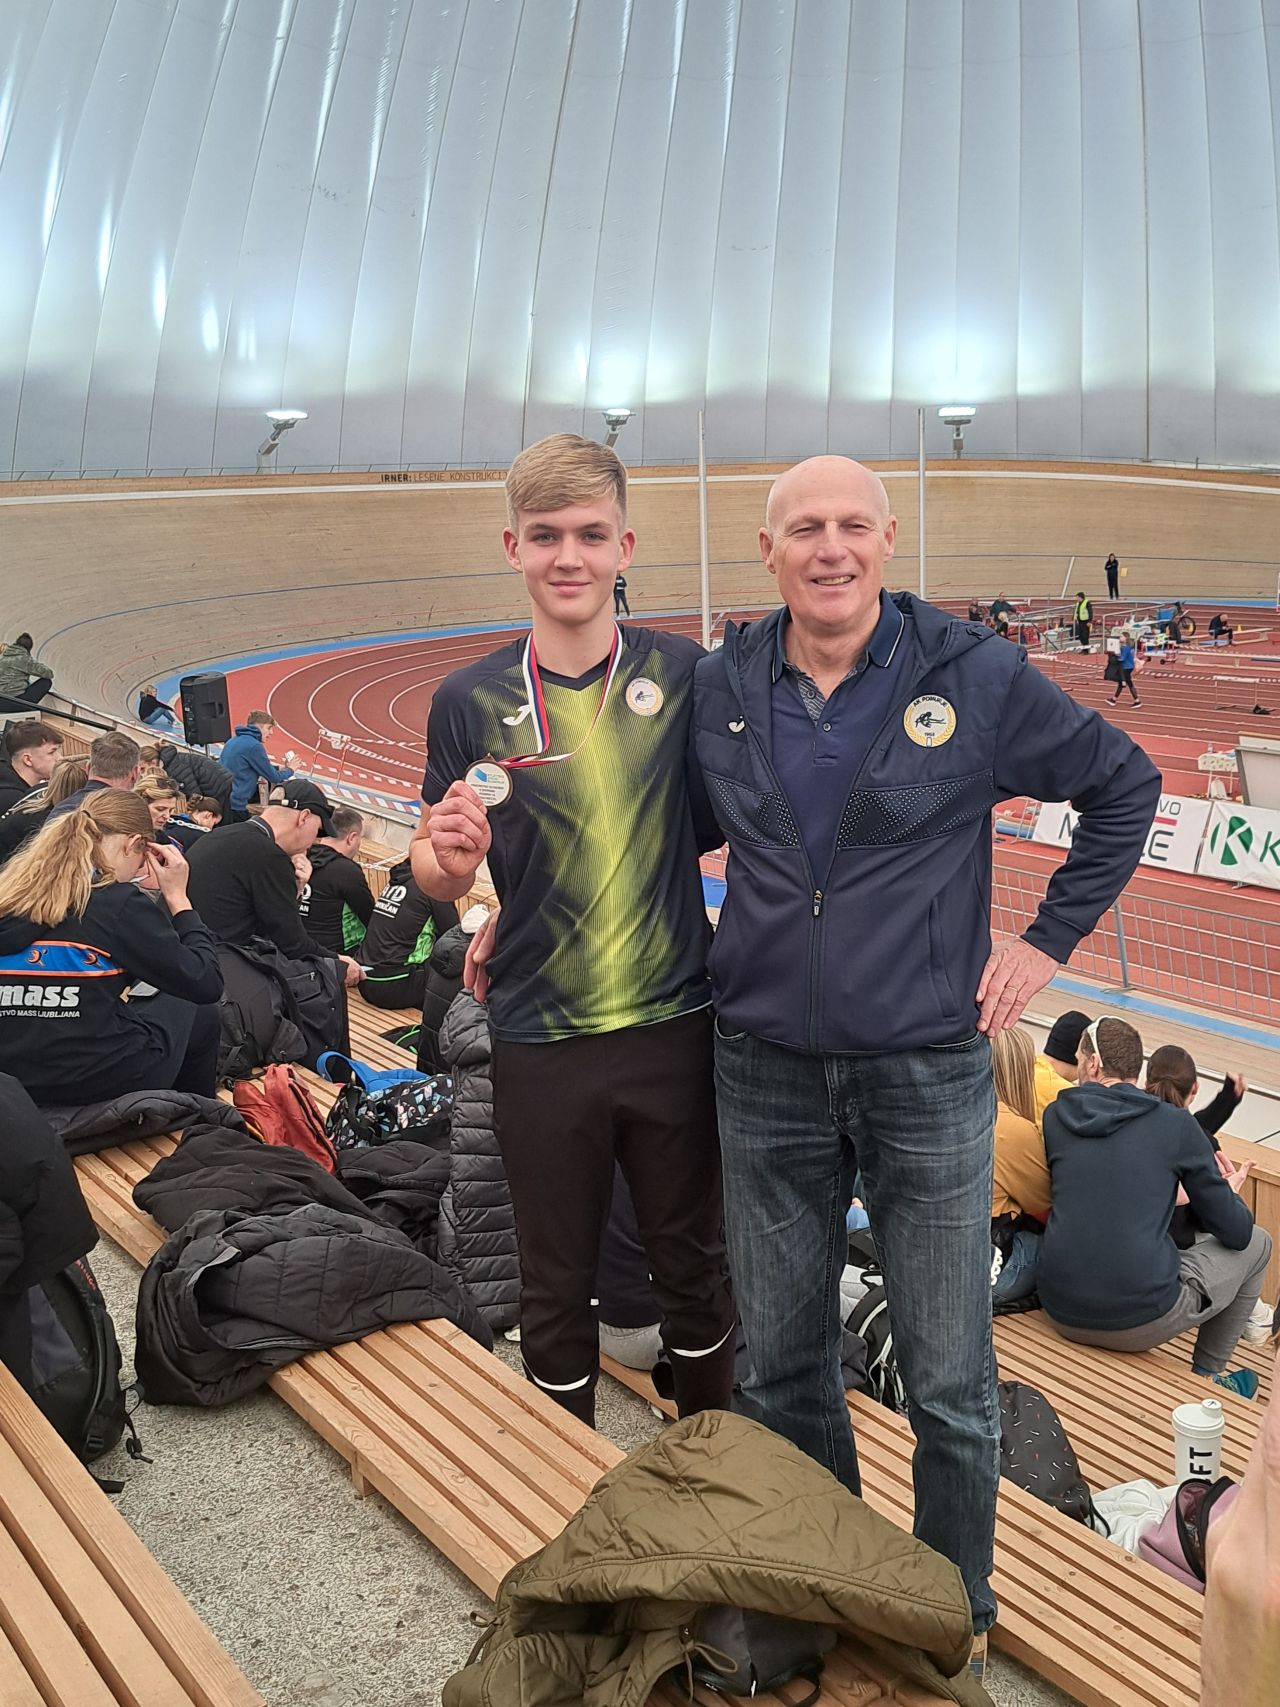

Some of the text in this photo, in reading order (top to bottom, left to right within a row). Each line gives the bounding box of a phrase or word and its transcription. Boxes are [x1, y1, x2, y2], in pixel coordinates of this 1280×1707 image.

[414, 472, 444, 482] LESENE
[16, 1009, 37, 1017] MASS
[37, 1010, 80, 1018] LJUBLJANA
[1190, 1446, 1212, 1480] FT
